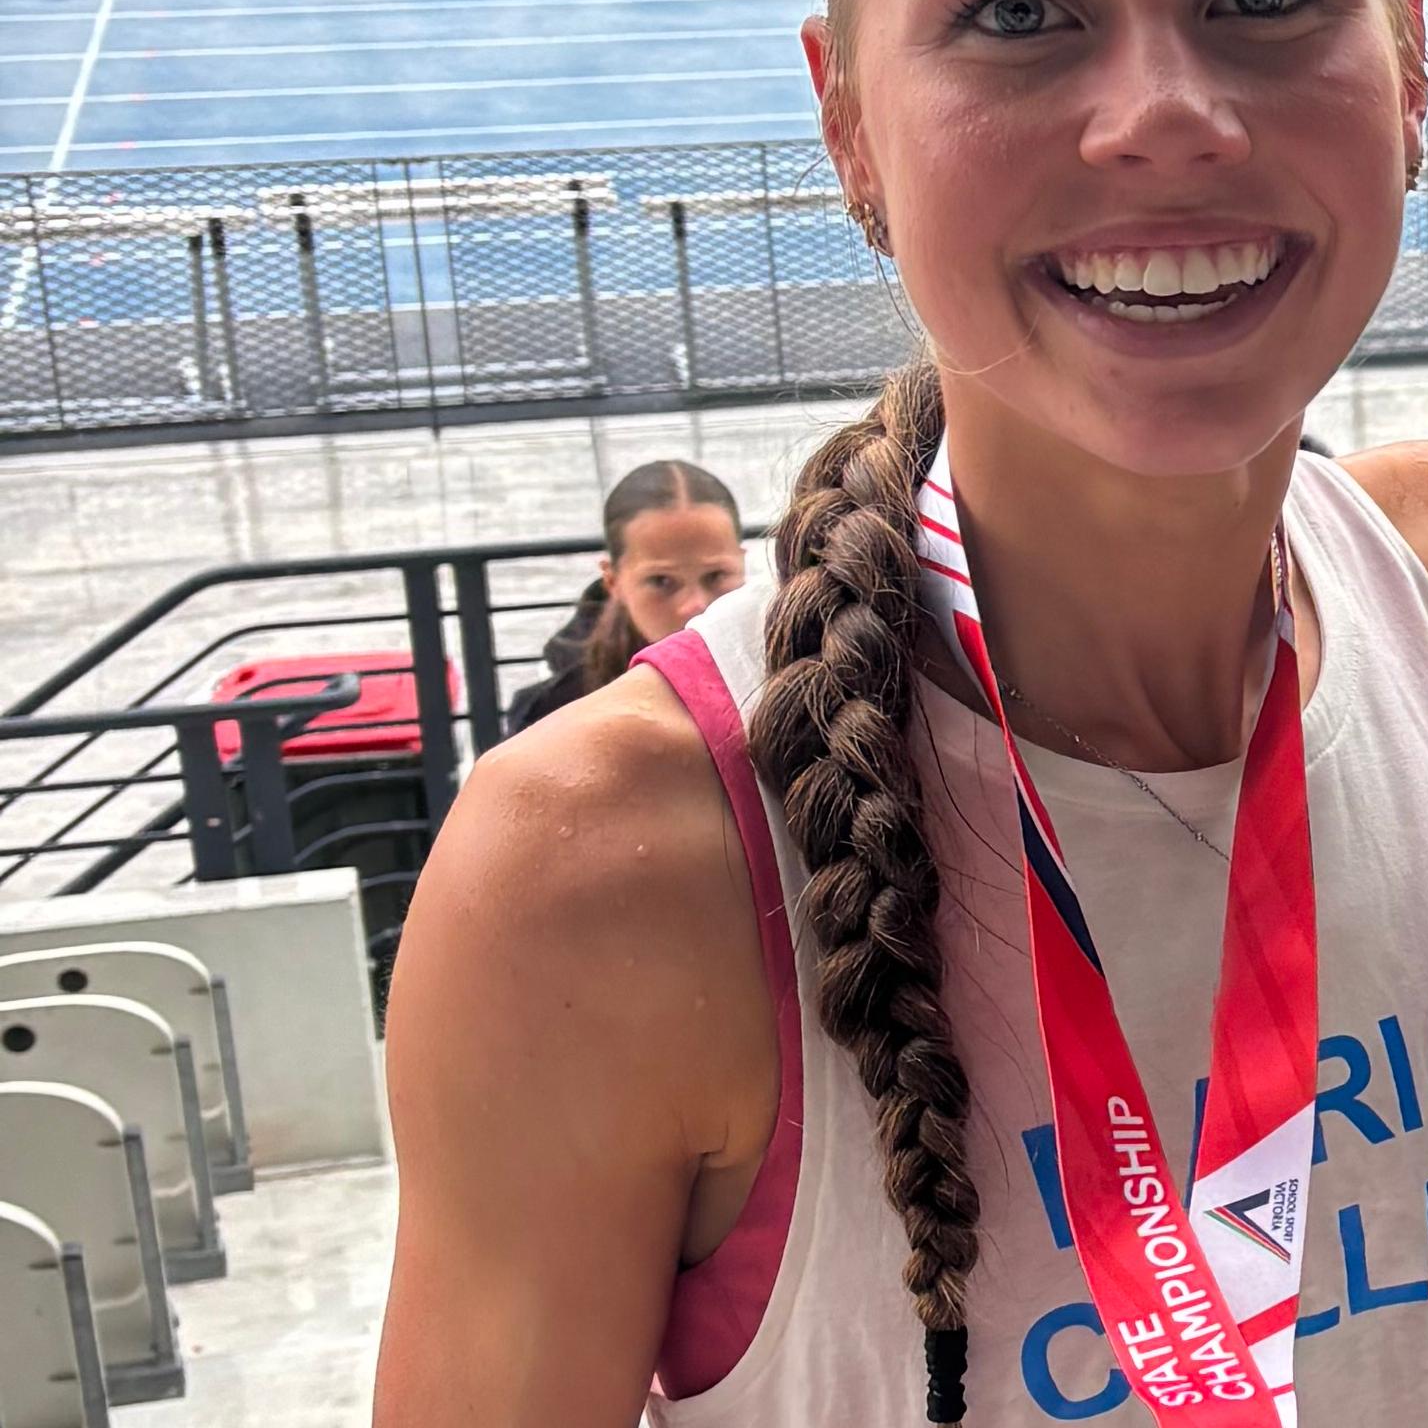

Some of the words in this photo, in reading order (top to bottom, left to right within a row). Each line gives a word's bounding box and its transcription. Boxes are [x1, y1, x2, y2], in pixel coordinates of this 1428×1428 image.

[1271, 1181, 1287, 1231] VICTORIA
[1286, 1178, 1299, 1214] SCHOOL
[1107, 1095, 1255, 1400] CHAMPIONSHIP
[1117, 1312, 1203, 1407] STATE
